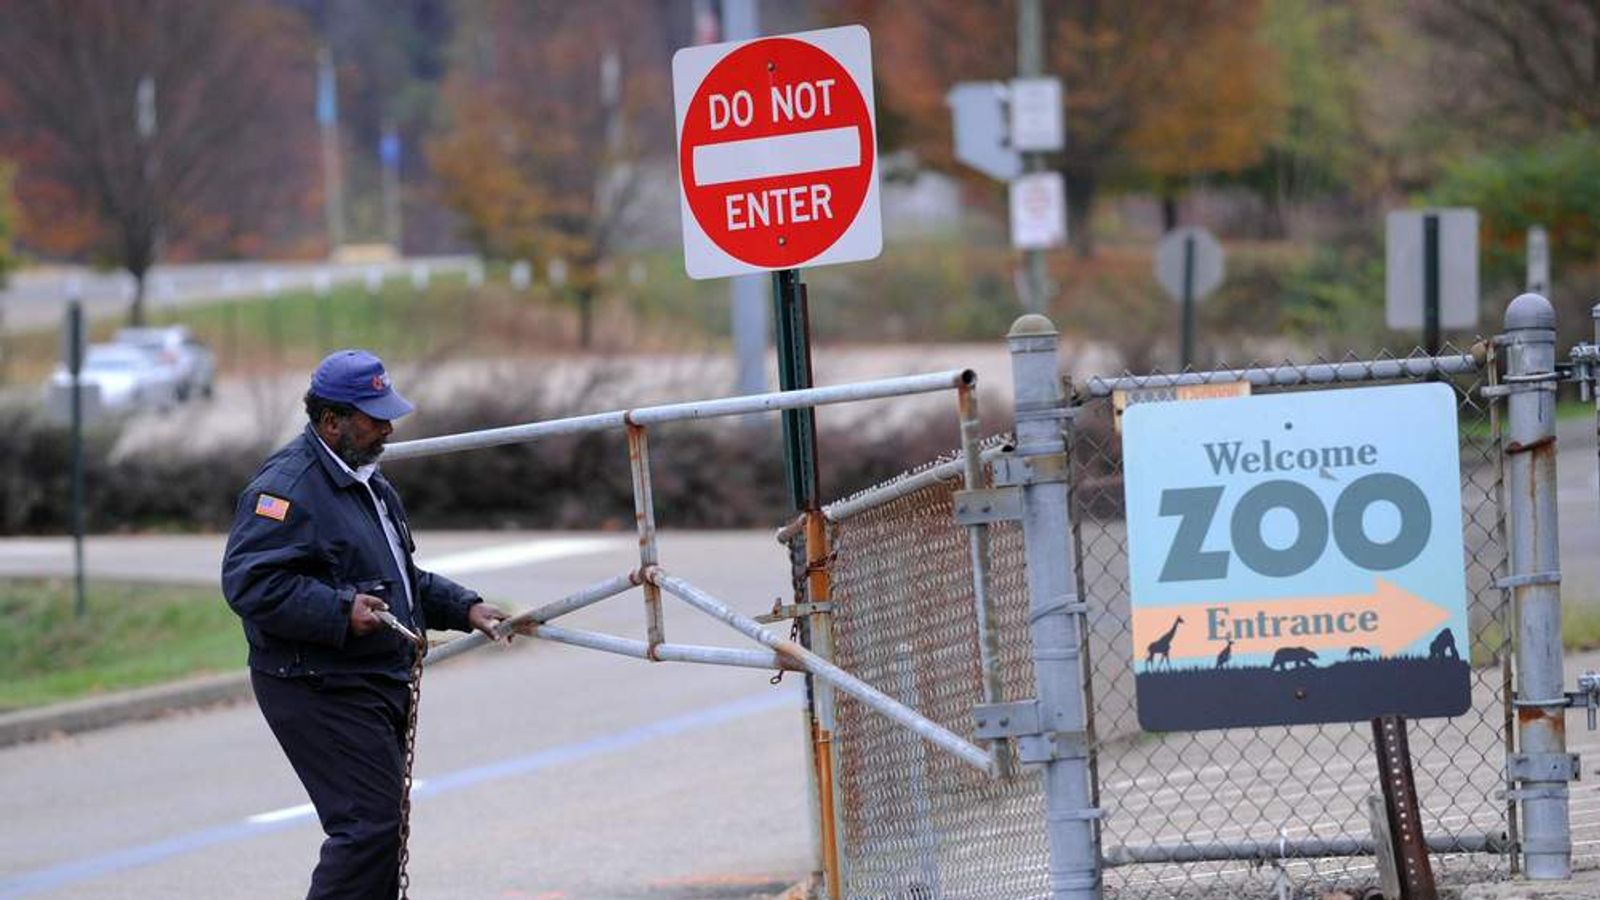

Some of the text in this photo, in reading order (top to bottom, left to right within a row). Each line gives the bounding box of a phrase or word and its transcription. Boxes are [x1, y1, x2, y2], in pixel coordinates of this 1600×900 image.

[709, 79, 836, 130] DO NOT
[726, 184, 833, 231] ENTER
[1203, 440, 1378, 475] Welcome
[1157, 472, 1432, 583] ZOO
[1206, 607, 1379, 641] Entrance
